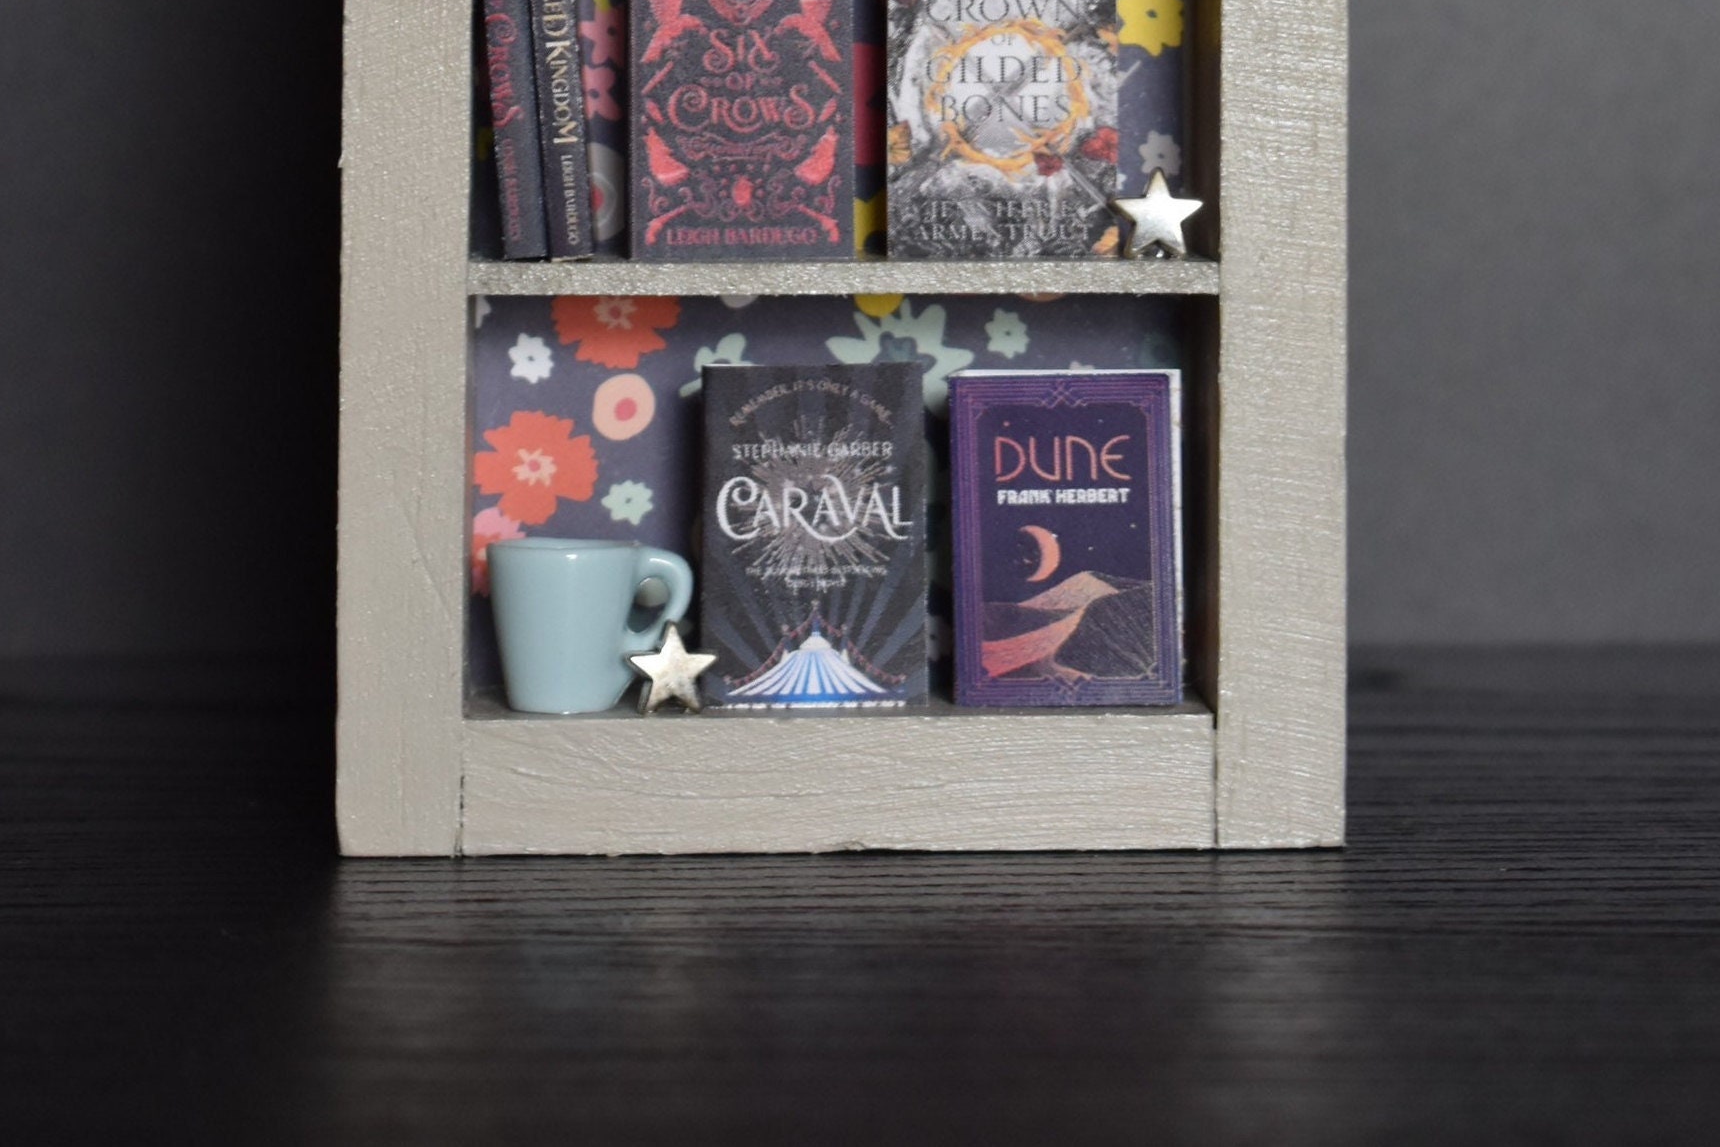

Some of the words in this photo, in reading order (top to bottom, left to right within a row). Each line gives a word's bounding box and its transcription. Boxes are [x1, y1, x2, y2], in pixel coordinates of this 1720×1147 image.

[702, 28, 782, 75] SIX
[484, 13, 525, 128] CROWS
[926, 56, 1082, 84] GILDED
[545, 41, 578, 145] KINGDOM
[668, 83, 816, 134] CROWS
[941, 94, 1071, 123] BONES
[560, 154, 575, 188] LEIGH
[562, 189, 579, 246] BARDUGO
[923, 200, 1049, 222] JEIFER
[667, 227, 720, 245] LEIGH
[724, 227, 818, 245] BARDUGO
[919, 224, 1094, 241] ARMETROUT
[731, 439, 823, 460] STEPHANIE
[827, 440, 894, 460] GARBER
[994, 434, 1132, 482] DUNE
[716, 475, 914, 543] CARAVAL
[997, 489, 1051, 505] FRANK
[1055, 487, 1131, 504] HERBERT
